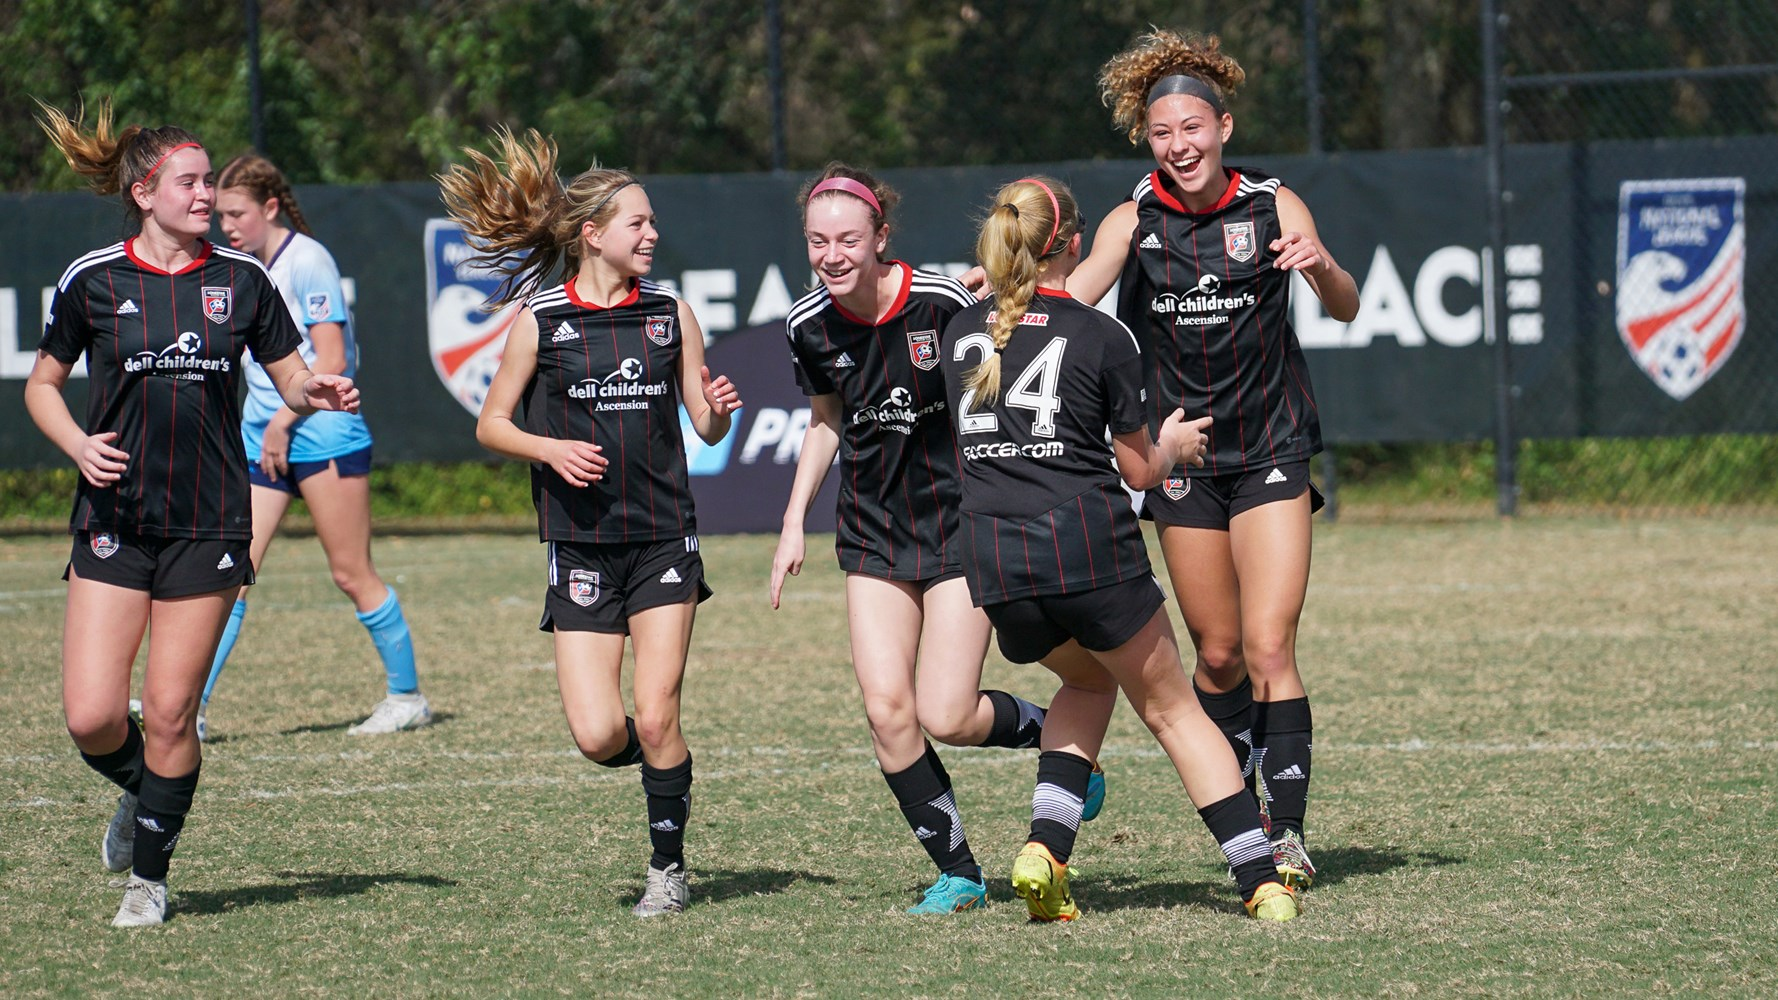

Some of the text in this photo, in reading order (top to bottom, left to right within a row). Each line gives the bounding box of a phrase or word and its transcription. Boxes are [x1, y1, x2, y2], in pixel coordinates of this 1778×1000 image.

[1151, 292, 1255, 313] dell children's
[1288, 244, 1543, 348] LACE
[1175, 314, 1229, 326] Ascension
[124, 355, 230, 372] dell children's
[567, 380, 668, 399] dell children's
[953, 333, 1067, 438] 24
[595, 400, 649, 411] Ascension
